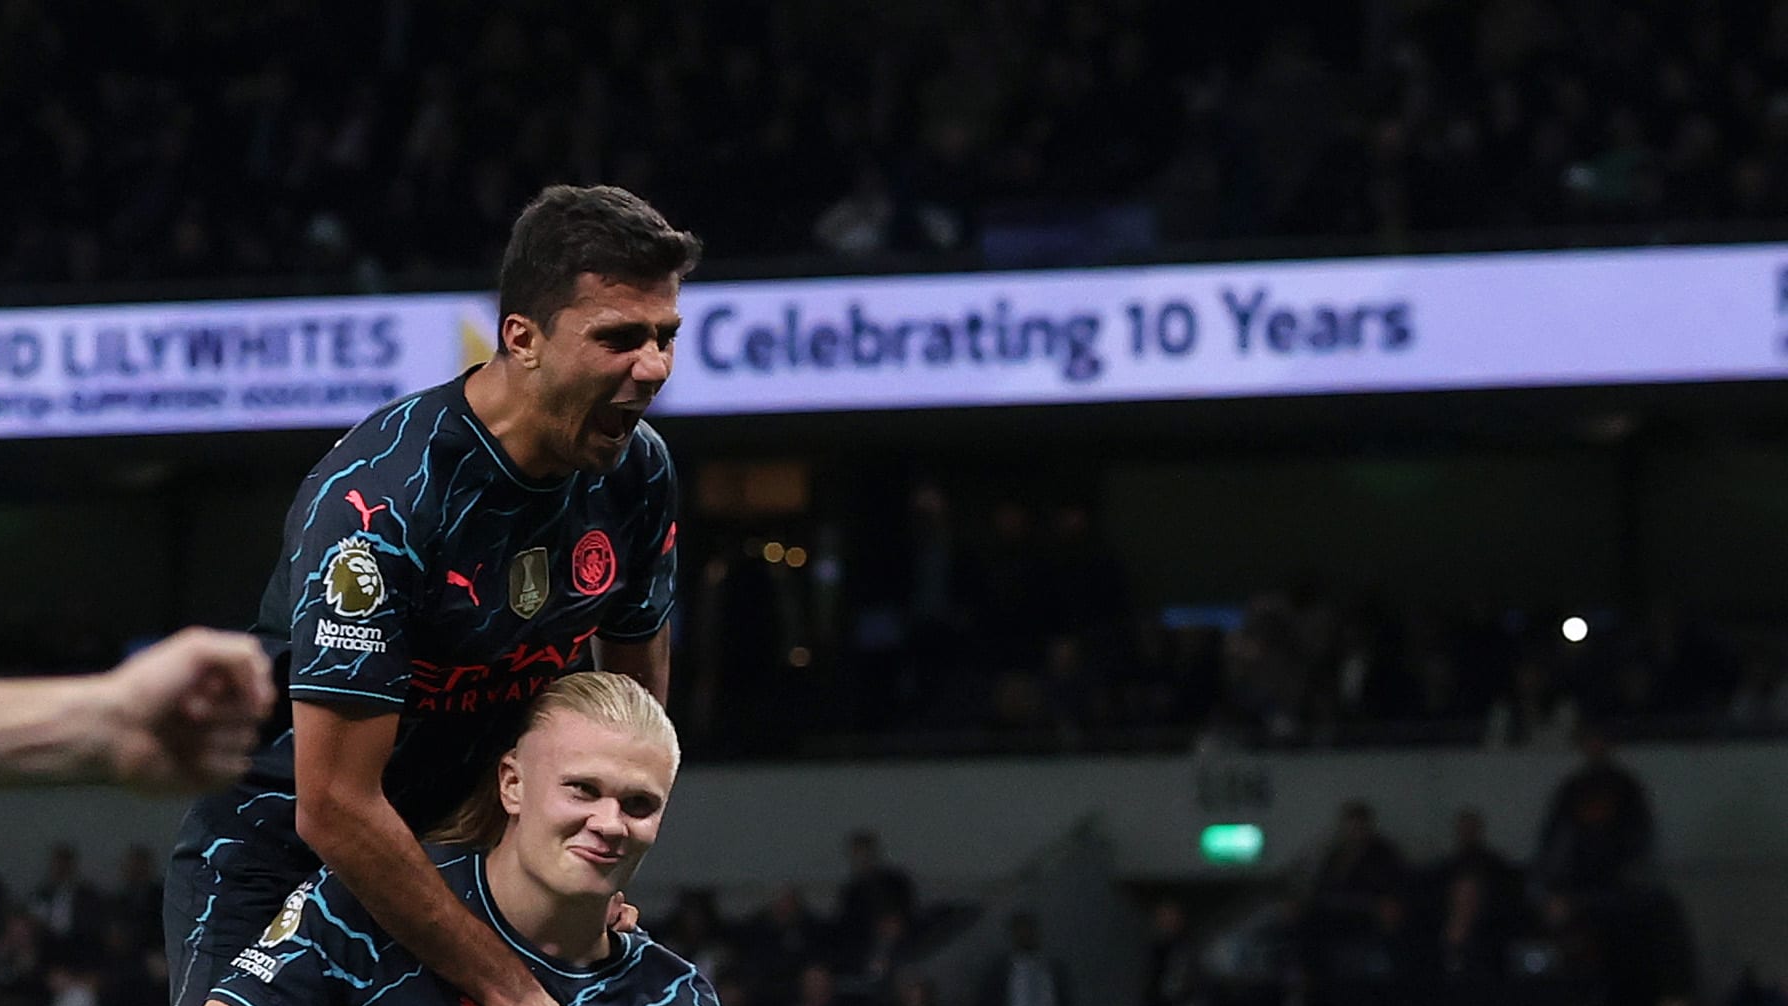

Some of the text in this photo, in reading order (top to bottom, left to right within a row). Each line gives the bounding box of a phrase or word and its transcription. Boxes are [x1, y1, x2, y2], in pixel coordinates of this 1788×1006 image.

[62, 316, 402, 376] LILYWHITES
[696, 286, 1412, 383] Celebrating 10 Years
[317, 618, 382, 640] No room
